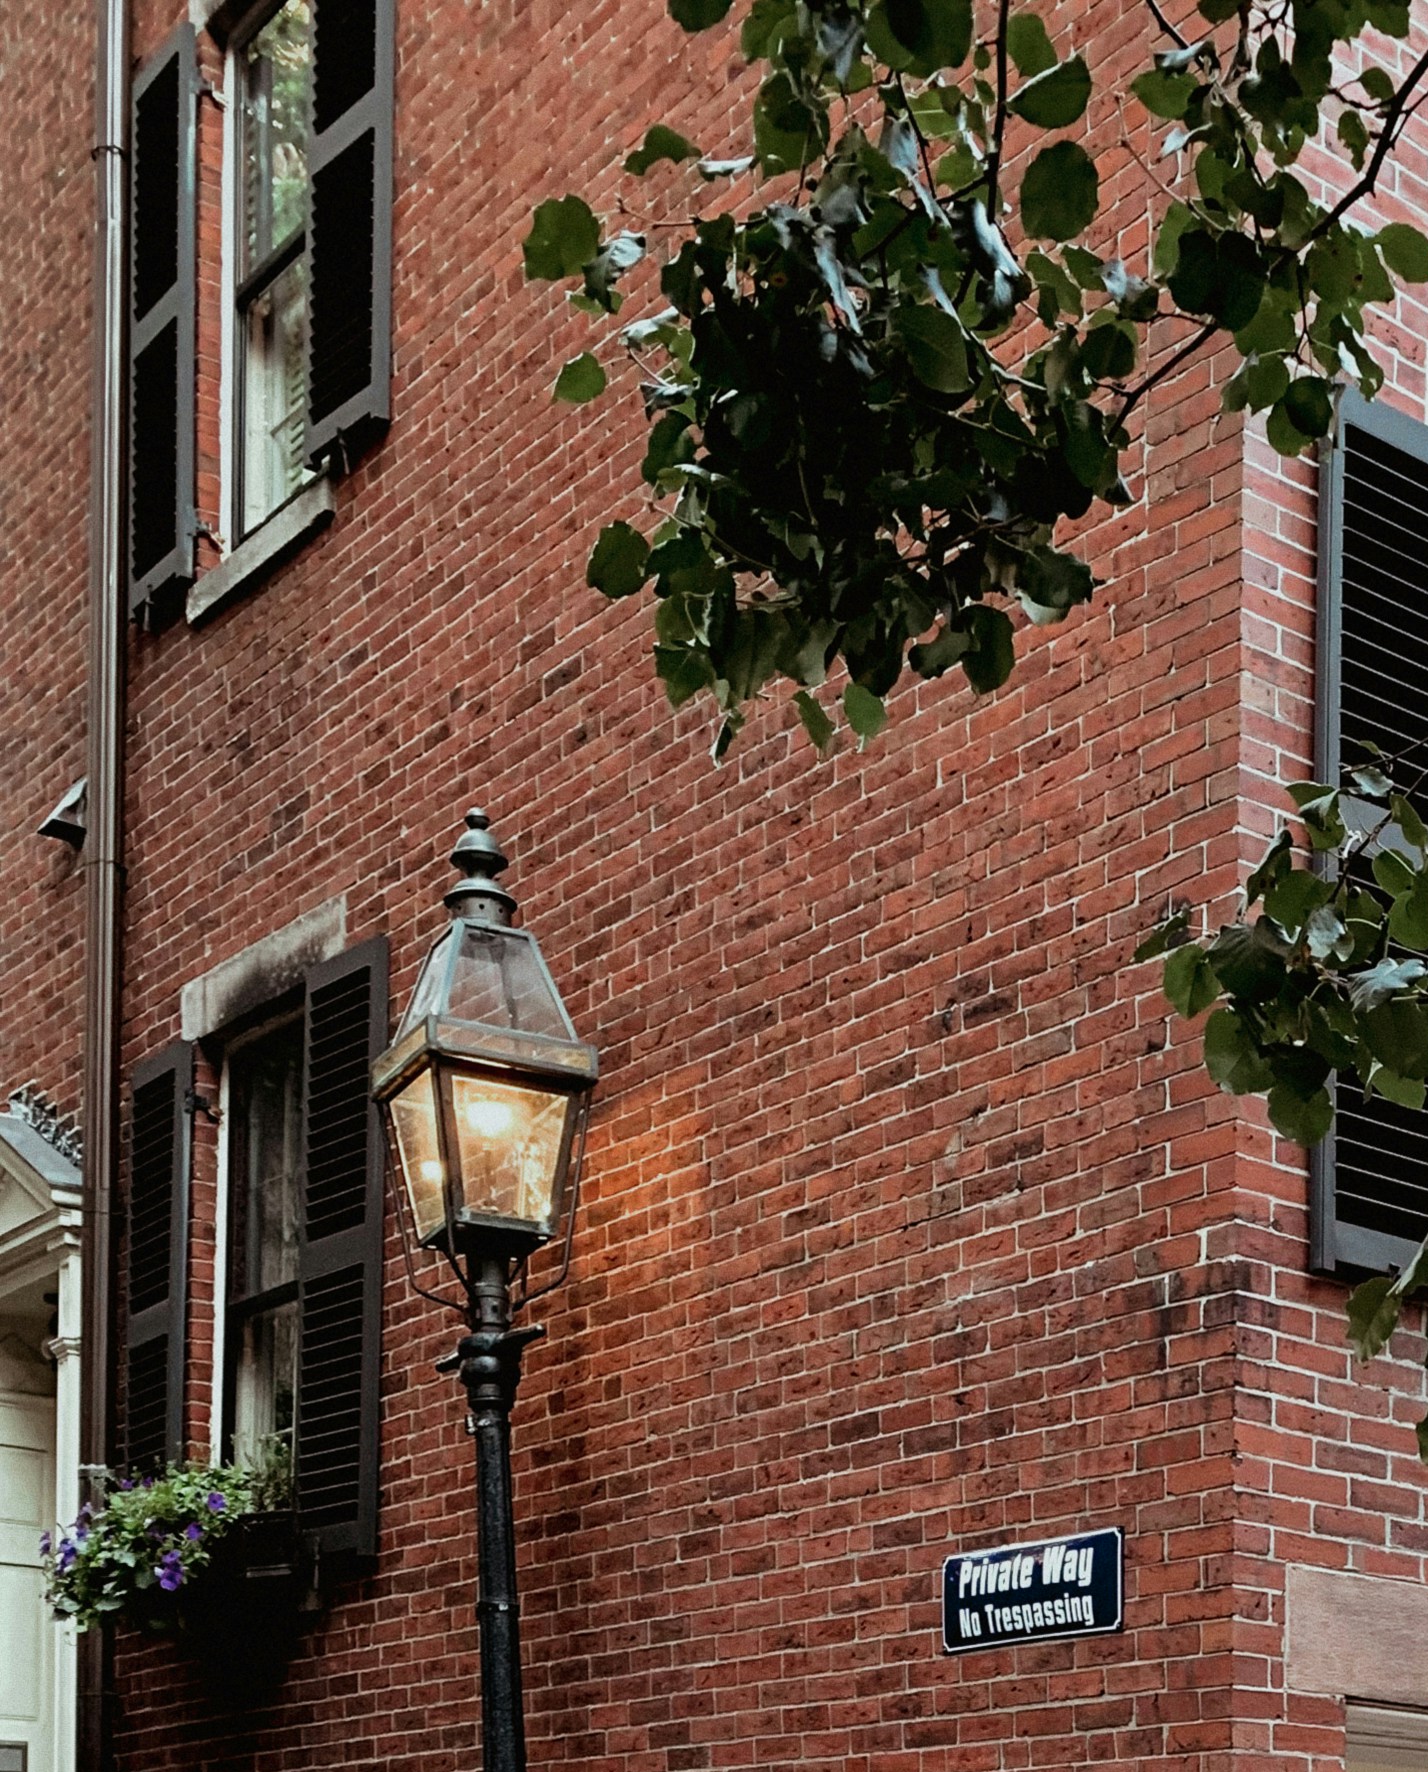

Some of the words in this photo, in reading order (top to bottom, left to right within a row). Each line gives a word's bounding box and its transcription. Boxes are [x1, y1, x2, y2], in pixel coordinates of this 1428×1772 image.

[959, 1553, 1035, 1599] Private
[1042, 1545, 1094, 1587] Way
[959, 1608, 982, 1638] No
[984, 1592, 1095, 1634] Trespassing
